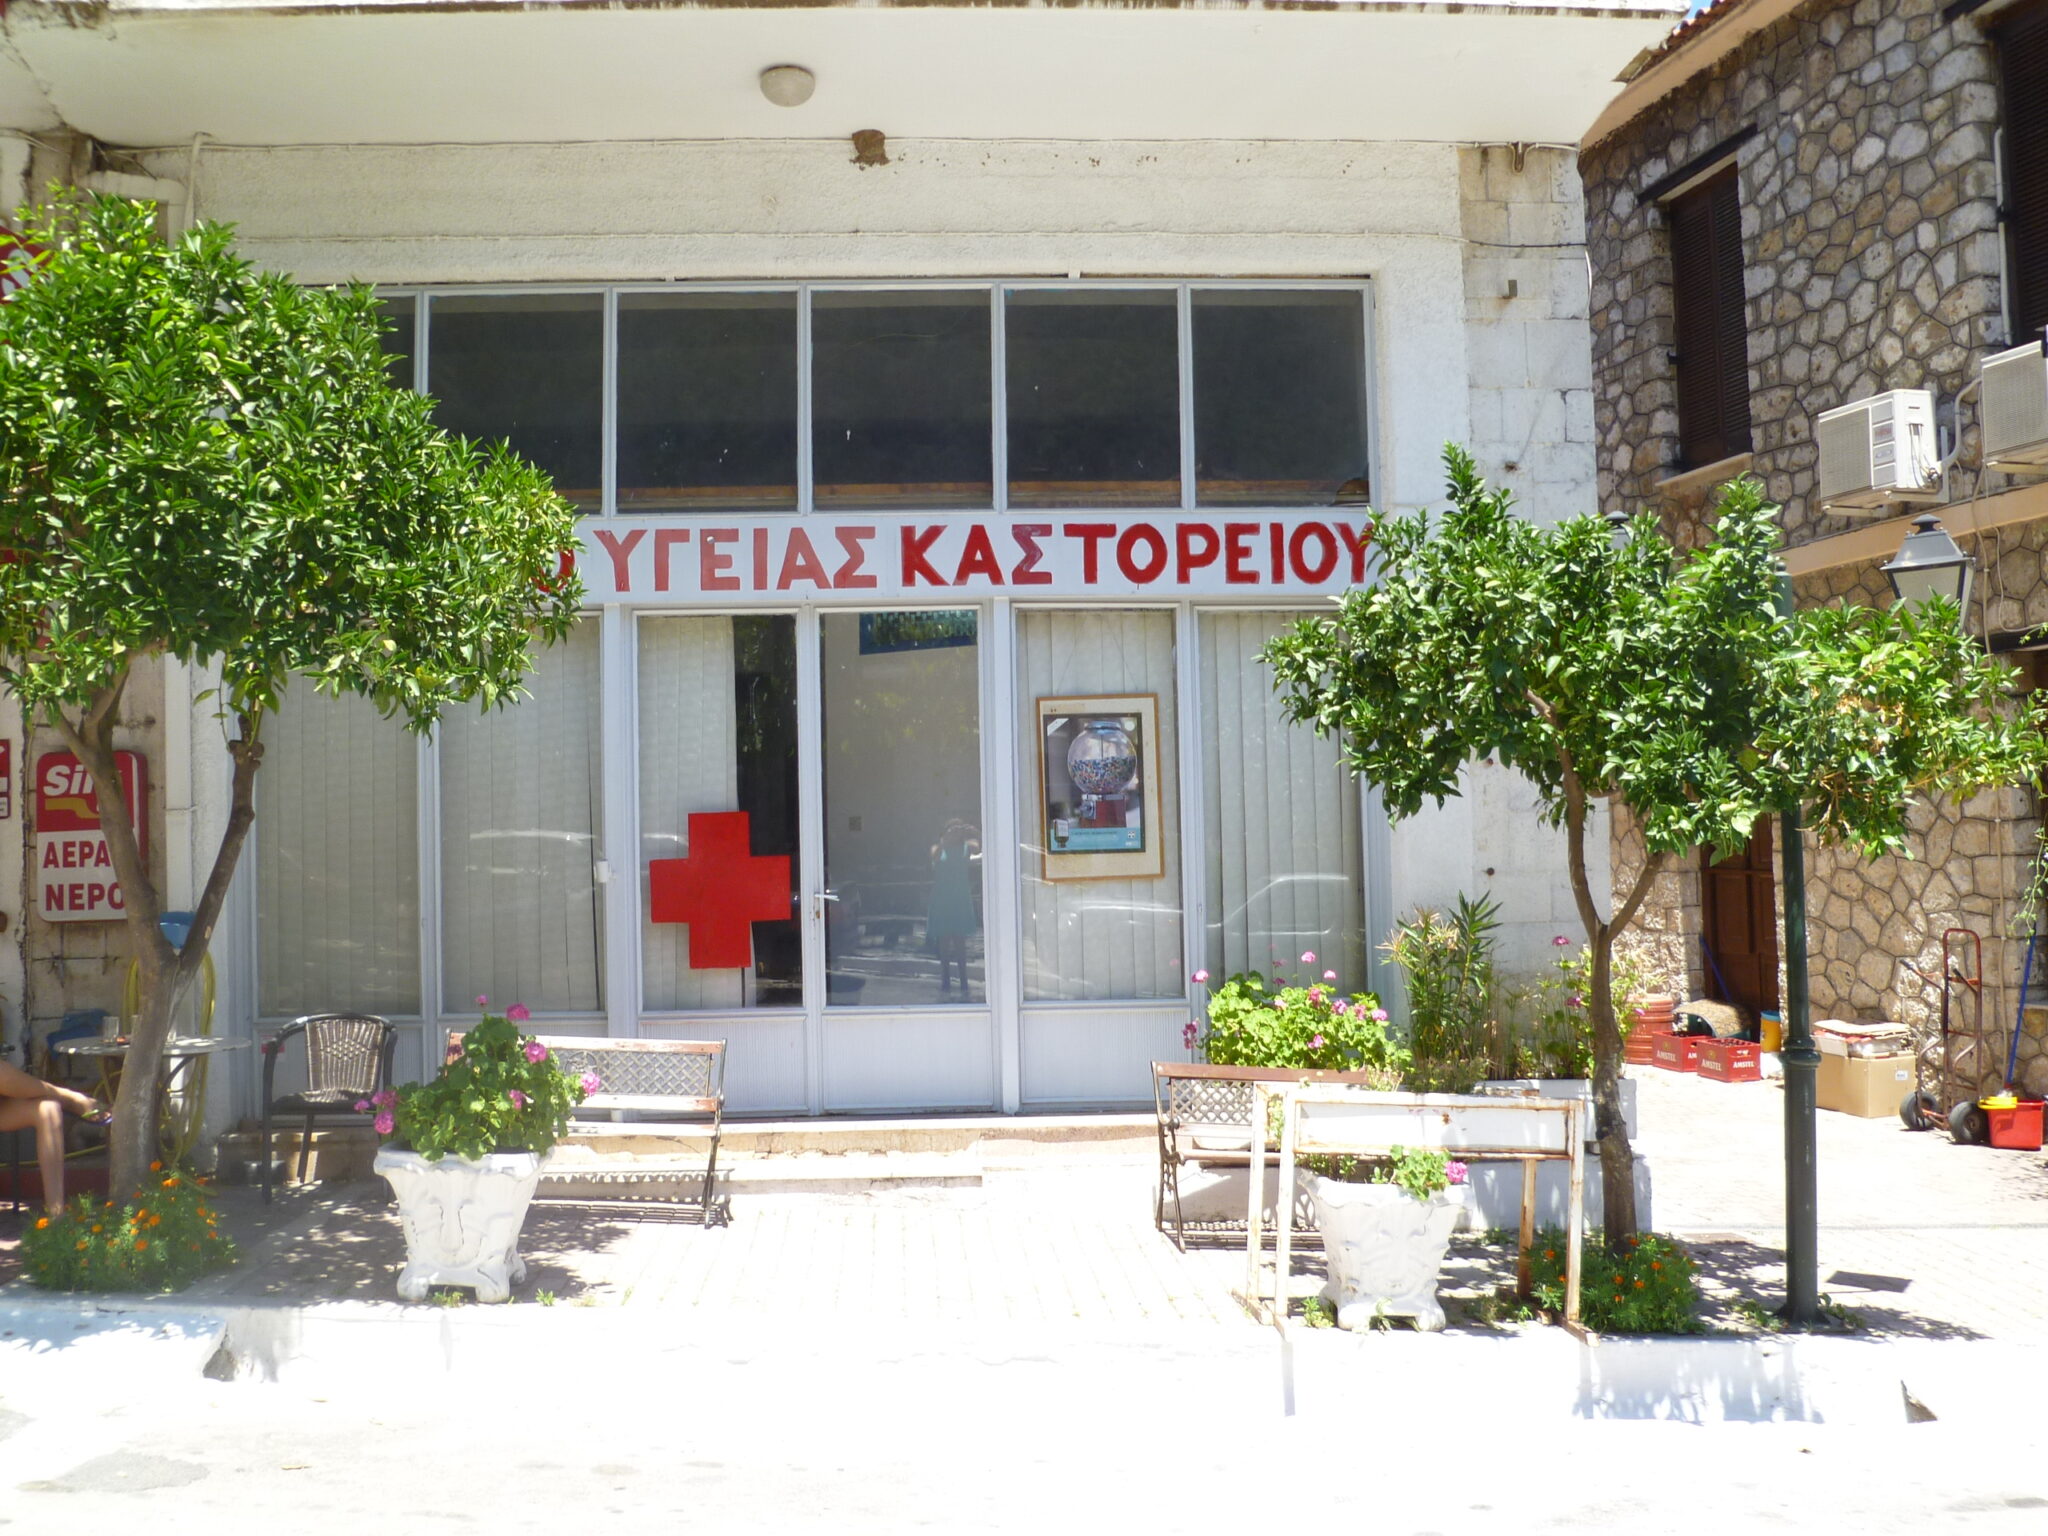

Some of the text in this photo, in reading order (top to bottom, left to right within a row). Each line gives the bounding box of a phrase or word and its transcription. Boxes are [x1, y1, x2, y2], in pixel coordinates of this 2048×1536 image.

[592, 526, 877, 592] ΥΓΕΙΑΣ
[900, 522, 1375, 587] ΚΑΣΤΟΡΕΙΟΥ
[43, 840, 112, 869] ΑΕΡΑ
[1656, 1050, 1677, 1063] AMSTEL
[1701, 1059, 1722, 1071] AMSTEL
[1733, 1061, 1755, 1069] AMSTEL
